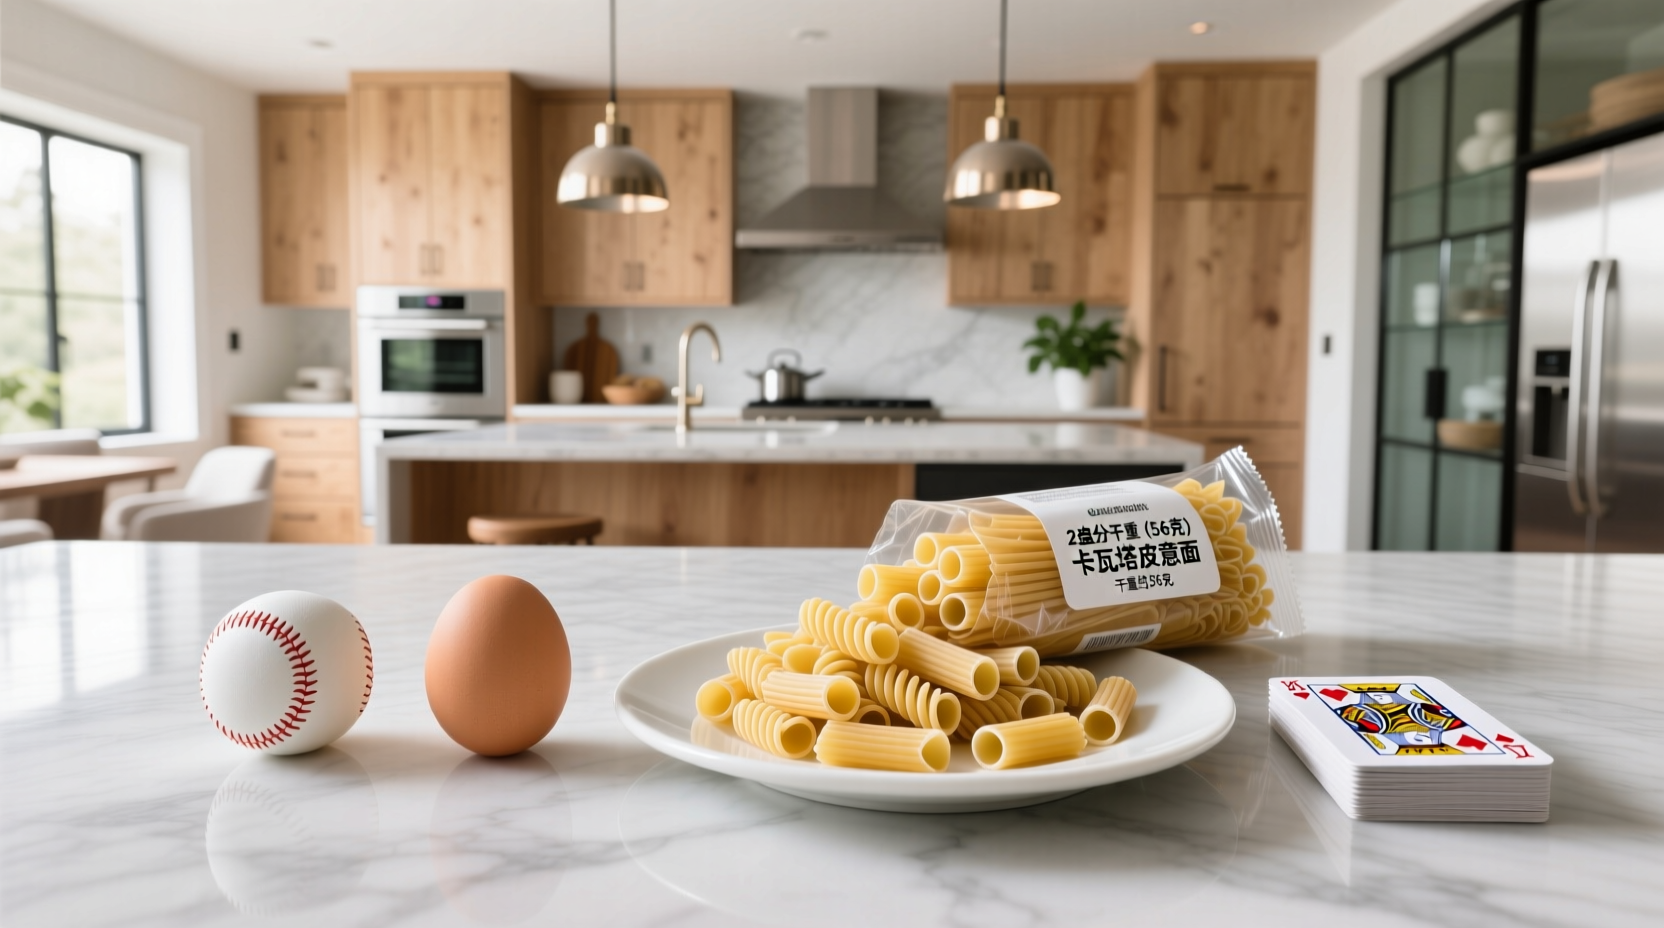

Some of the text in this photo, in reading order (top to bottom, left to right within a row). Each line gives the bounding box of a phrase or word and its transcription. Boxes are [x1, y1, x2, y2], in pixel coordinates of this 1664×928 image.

[1072, 540, 1201, 576] 卡瓦塔皮意面
